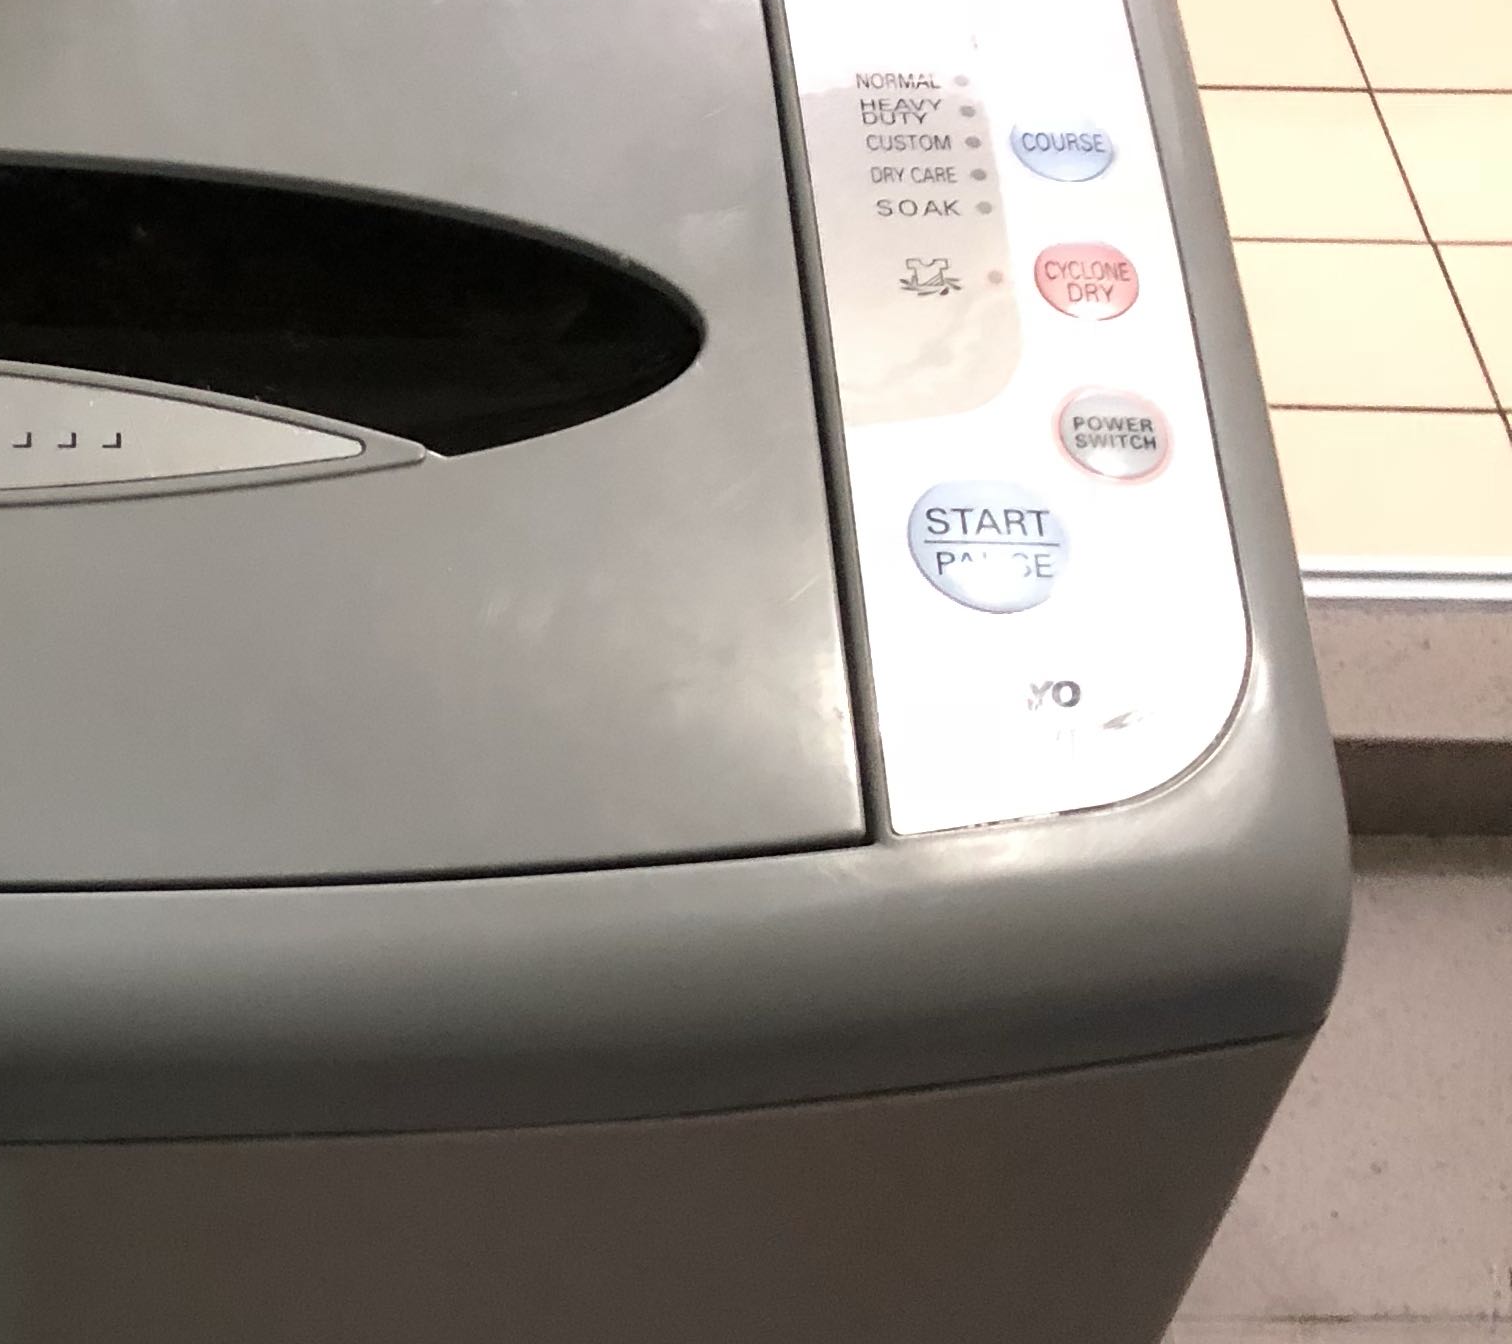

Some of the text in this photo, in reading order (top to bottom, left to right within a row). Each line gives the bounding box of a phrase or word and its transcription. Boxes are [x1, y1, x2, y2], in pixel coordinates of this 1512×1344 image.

[856, 71, 942, 90] NORMAL
[859, 98, 943, 112] HEAVY
[861, 112, 928, 126] DUTY
[865, 135, 953, 152] CUSTOM
[1021, 131, 1107, 154] COURSE
[870, 166, 959, 184] DRY CARE
[875, 199, 962, 217] SOAK
[1044, 260, 1131, 282] CYCLONE
[1066, 283, 1114, 304] DRY
[1072, 416, 1154, 433] POWER
[1074, 434, 1158, 451] SWITCH
[924, 508, 1050, 537] START
